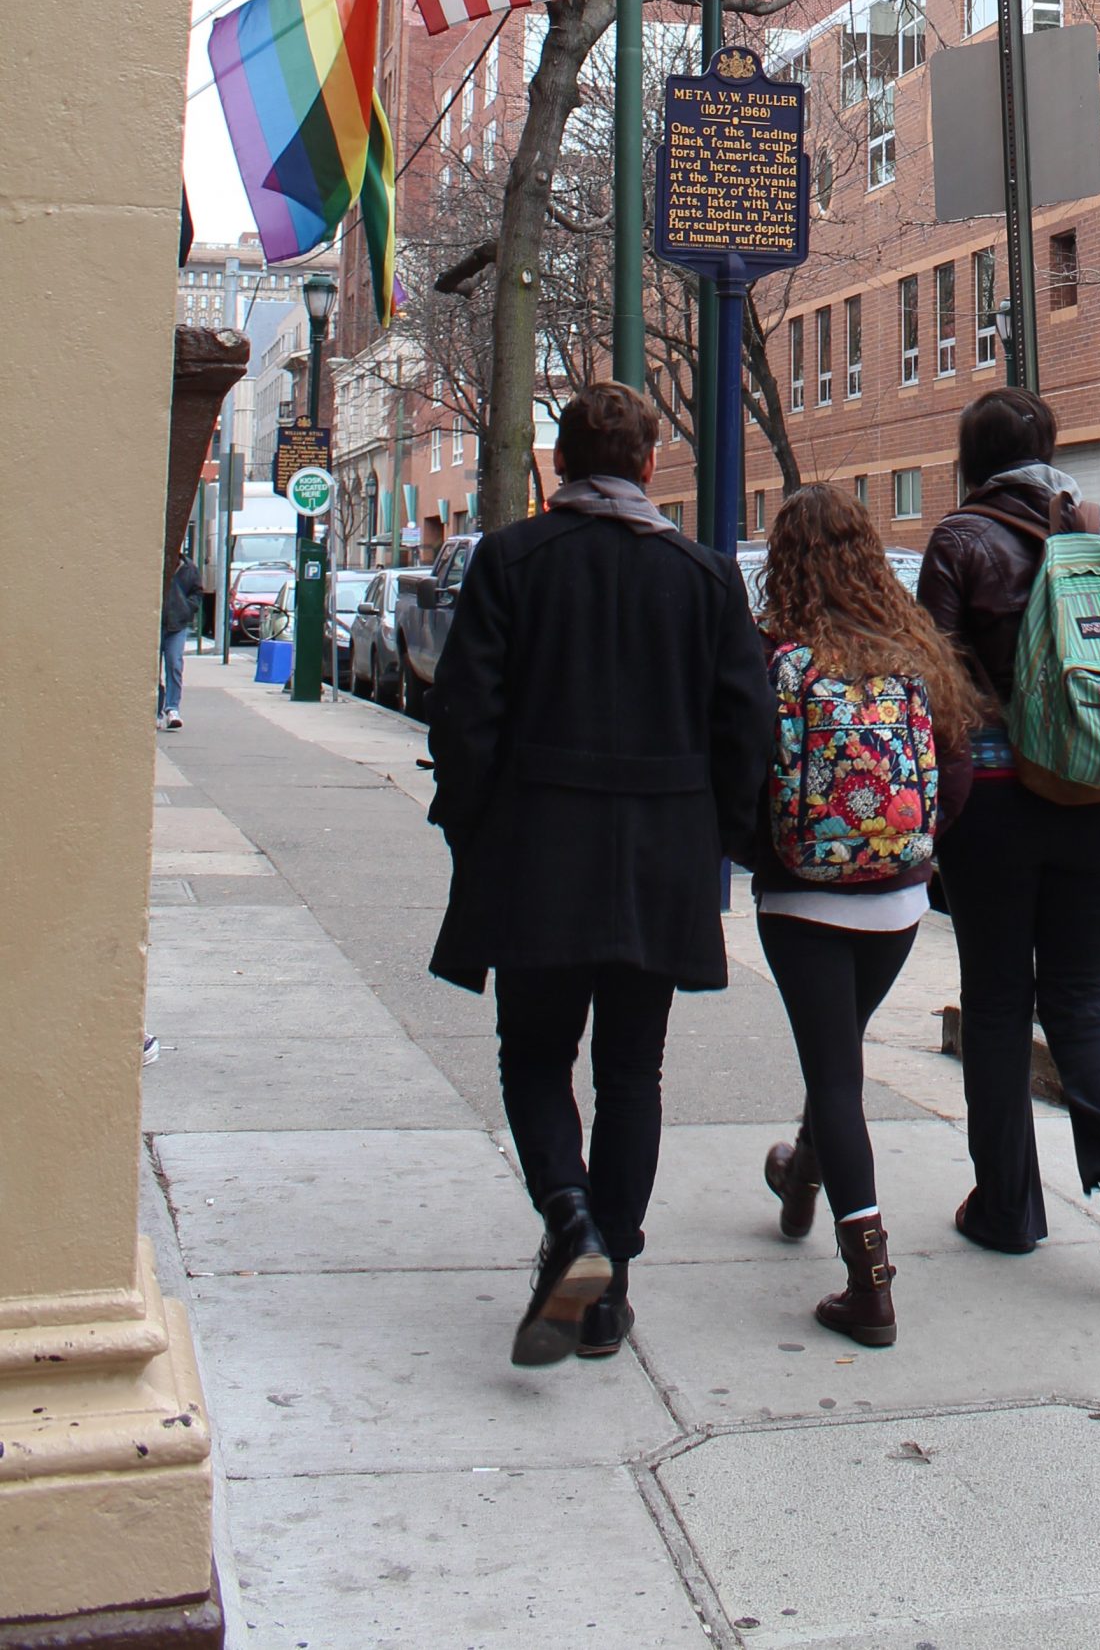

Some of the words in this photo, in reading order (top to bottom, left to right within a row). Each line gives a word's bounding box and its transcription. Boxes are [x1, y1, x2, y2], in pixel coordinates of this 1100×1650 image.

[674, 88, 712, 101] META
[748, 93, 797, 107] FULLER
[671, 122, 696, 134] One
[703, 125, 717, 135] of
[724, 126, 745, 137] the
[752, 127, 797, 142] leading
[671, 134, 704, 147] Black
[711, 137, 752, 149] female
[759, 141, 797, 153] sculp-
[671, 147, 695, 158] tors
[700, 148, 711, 159] in
[716, 149, 768, 162] America.
[775, 152, 797, 164] She
[671, 158, 700, 170] lived
[750, 164, 797, 175] studied
[670, 171, 683, 181] at
[689, 171, 708, 183] the
[715, 172, 797, 187] Pennsylvania
[671, 182, 726, 197] Academy
[730, 186, 744, 196] of
[747, 186, 767, 197] the
[770, 188, 797, 199] Fine
[708, 196, 738, 207] later
[743, 199, 769, 209] with
[775, 200, 797, 210] Au-
[669, 208, 704, 219] guste
[707, 208, 743, 221] Rodin
[747, 211, 758, 221] in
[762, 211, 797, 223] Paris.
[669, 218, 691, 229] Her
[693, 220, 752, 233] sculpture
[754, 222, 797, 236] depict-
[668, 231, 684, 241] ed
[689, 231, 730, 243] human
[735, 234, 796, 248] suffering.
[301, 490, 321, 498] HERE
